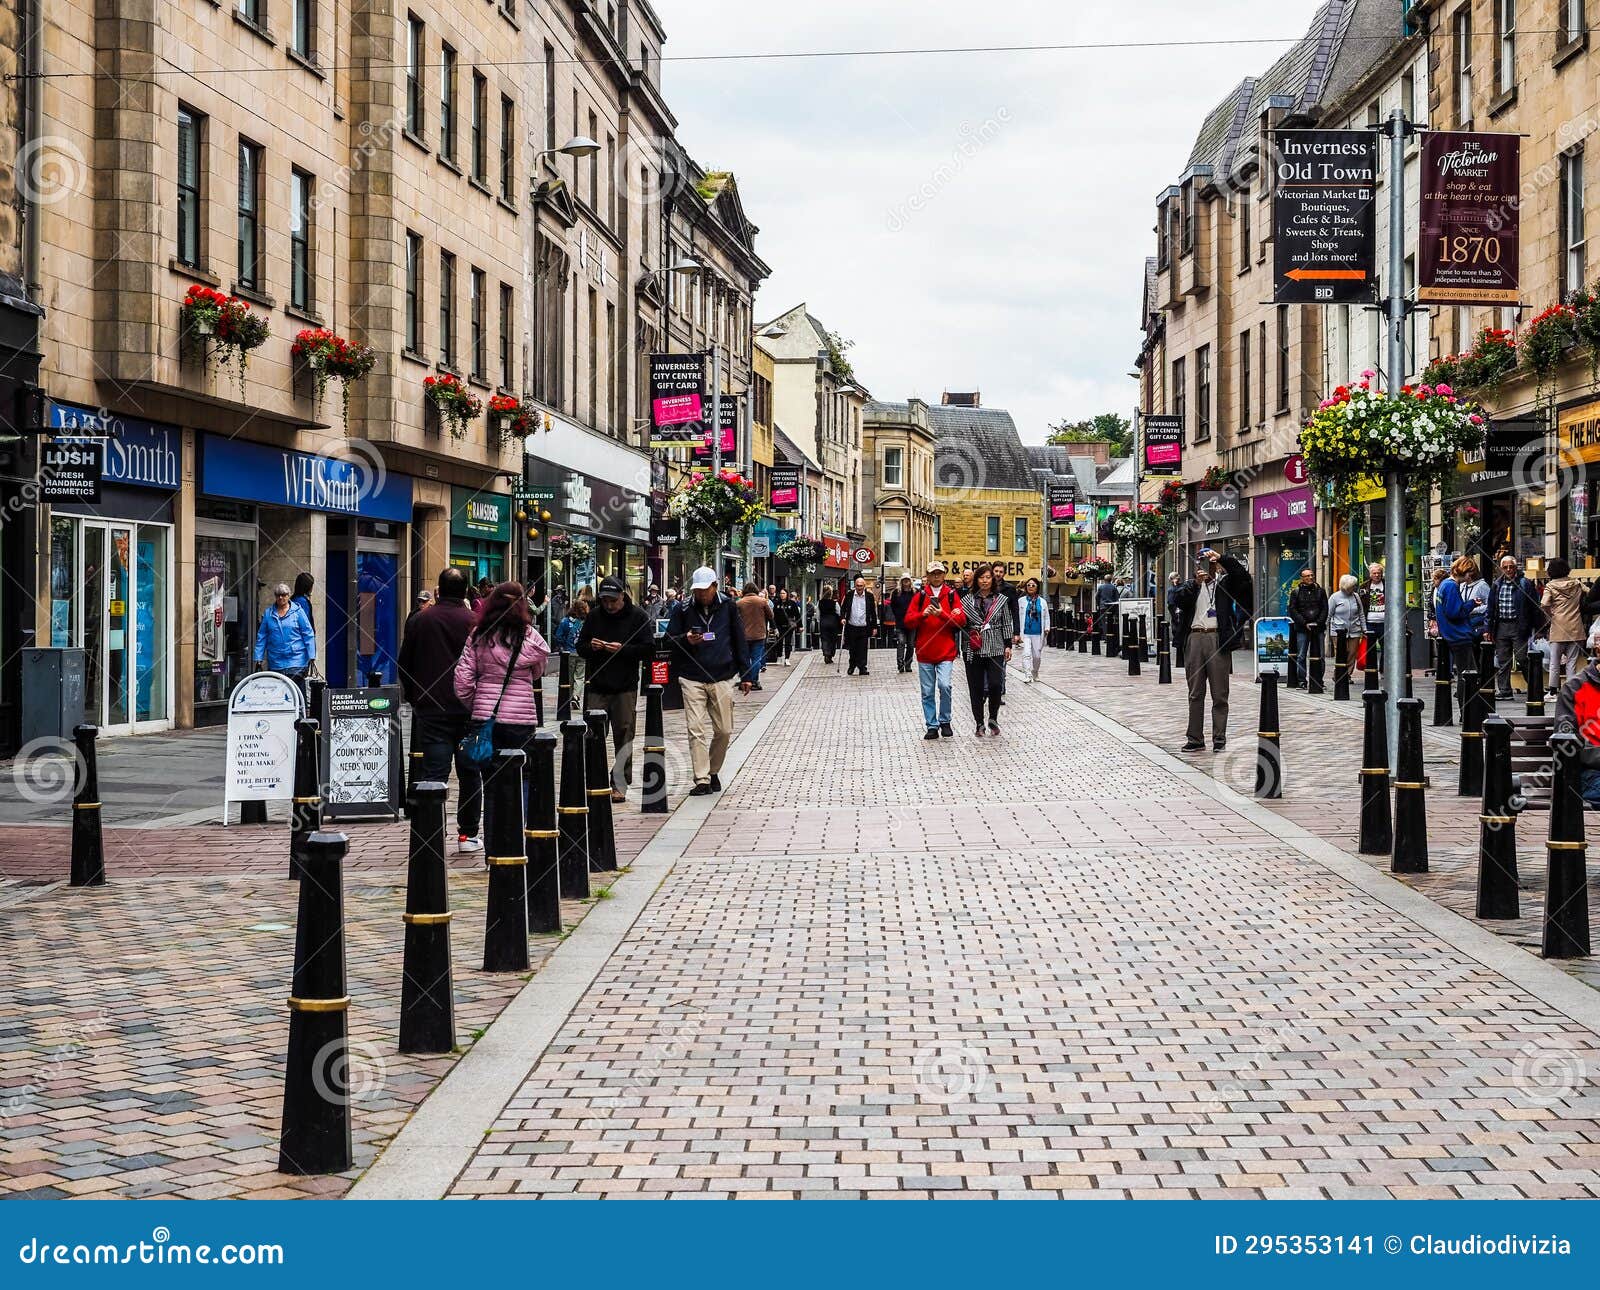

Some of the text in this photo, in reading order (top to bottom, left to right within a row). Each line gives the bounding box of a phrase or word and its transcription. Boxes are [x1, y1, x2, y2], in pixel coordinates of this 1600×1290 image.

[1284, 138, 1366, 155] Inverness
[1462, 142, 1480, 150] THE
[1437, 150, 1498, 176] Victorian
[1278, 162, 1372, 180] Old Town
[1454, 168, 1488, 177] MARKET
[1446, 181, 1466, 192] shop
[1468, 182, 1476, 190] &
[1277, 190, 1356, 199] Victorian Market
[1424, 192, 1432, 200] at
[1434, 192, 1448, 200] the
[1450, 192, 1472, 200] heart
[1474, 192, 1484, 202] of
[1301, 202, 1350, 213] Boutiques,
[1292, 214, 1358, 225] Cafes & Bars,
[1286, 228, 1364, 237] Sweets & Treats,
[1312, 240, 1339, 250] Shops
[1439, 236, 1500, 264] 1870
[1292, 252, 1358, 262] and lots more!
[1434, 276, 1470, 284] independent
[1315, 288, 1332, 297] BID
[1428, 290, 1508, 299] thevictorianmarket.co.uk
[672, 372, 702, 380] CENTRE
[656, 382, 674, 390] GIFT
[661, 396, 692, 405] INVERNESS
[1569, 422, 1584, 449] THE
[46, 451, 94, 465] LUSH
[1470, 472, 1478, 482] OF
[282, 453, 360, 512] WHSmith
[1200, 500, 1236, 511] Clarks
[472, 501, 498, 522] RAMSDENS
[952, 560, 960, 574] &
[351, 734, 369, 742] YOUR
[336, 748, 383, 756] COUNTRYSIDE
[340, 762, 378, 771] NEEDS YOU!
